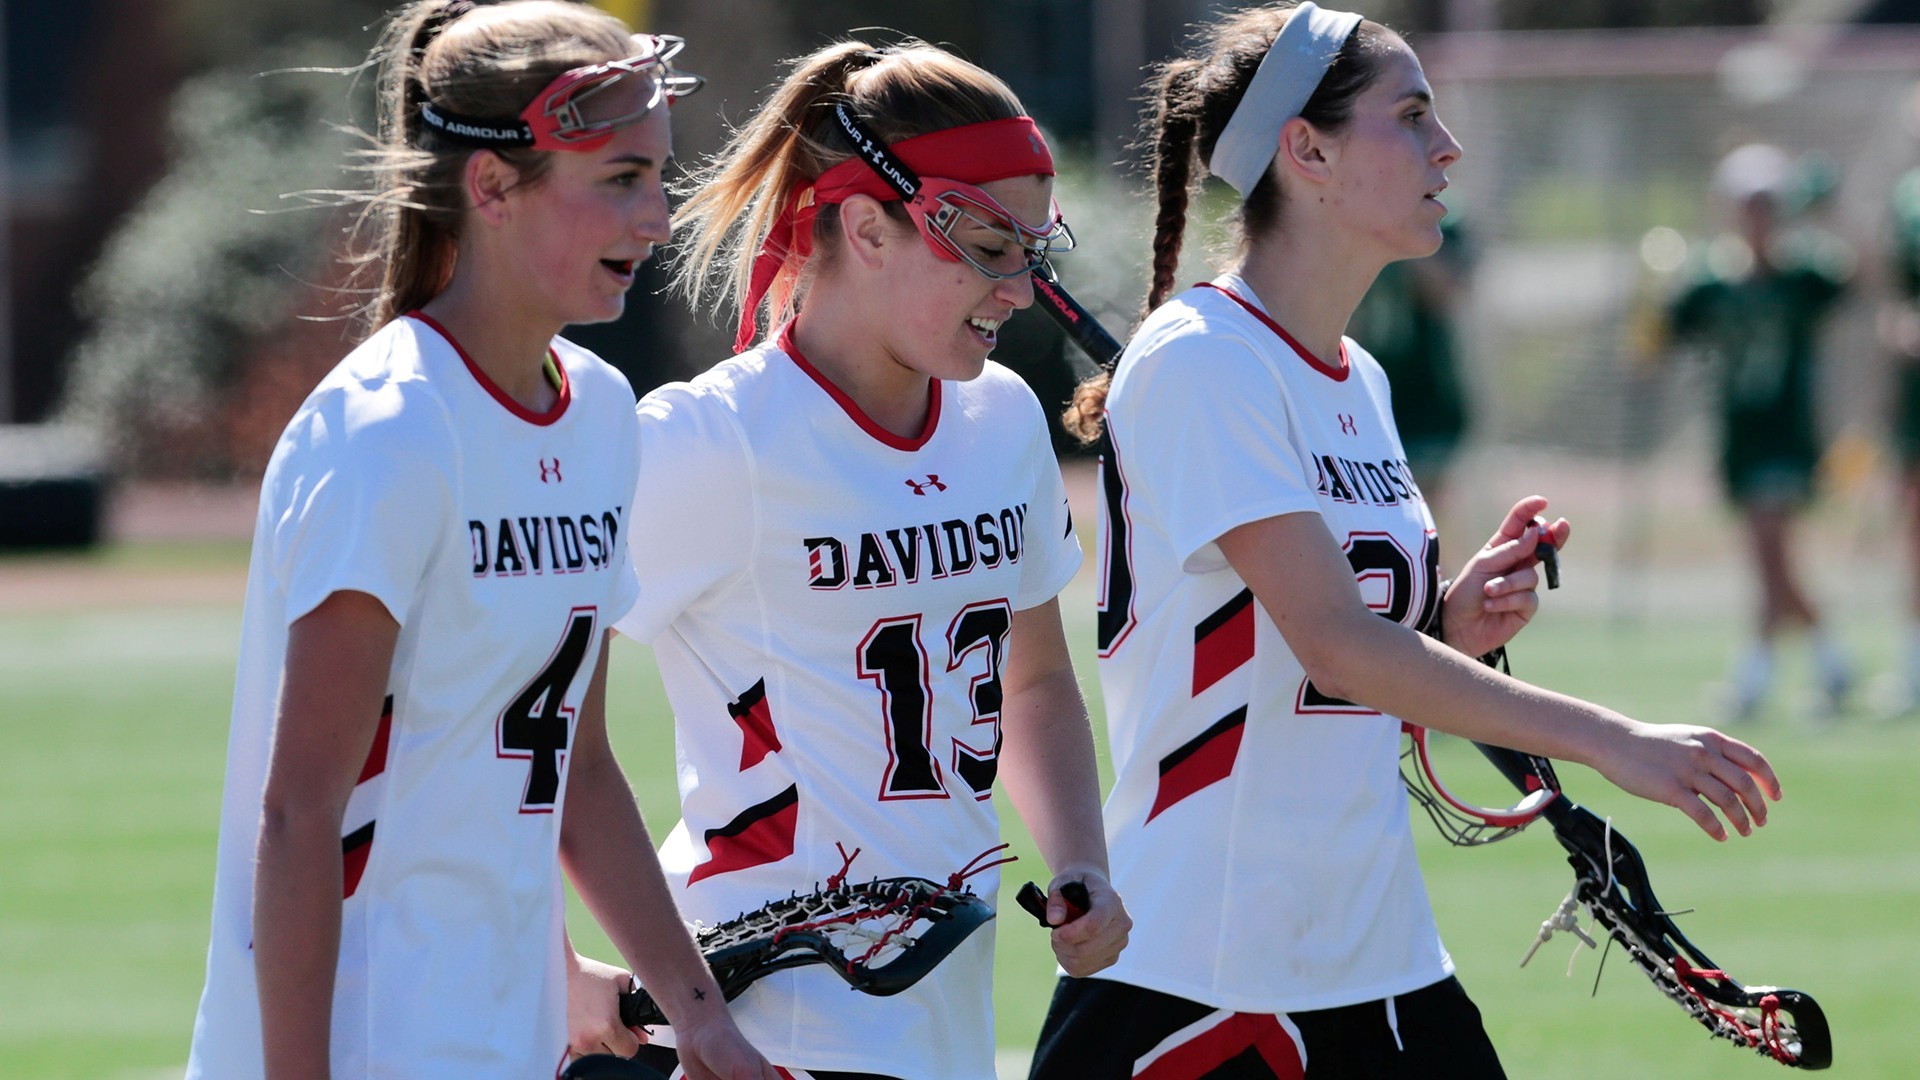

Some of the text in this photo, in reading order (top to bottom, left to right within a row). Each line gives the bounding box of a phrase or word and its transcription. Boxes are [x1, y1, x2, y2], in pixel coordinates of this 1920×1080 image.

[446, 121, 519, 139] ARMOUR
[468, 506, 622, 578] DAVIDSO
[495, 605, 597, 814] 4
[856, 597, 1014, 802] 13
